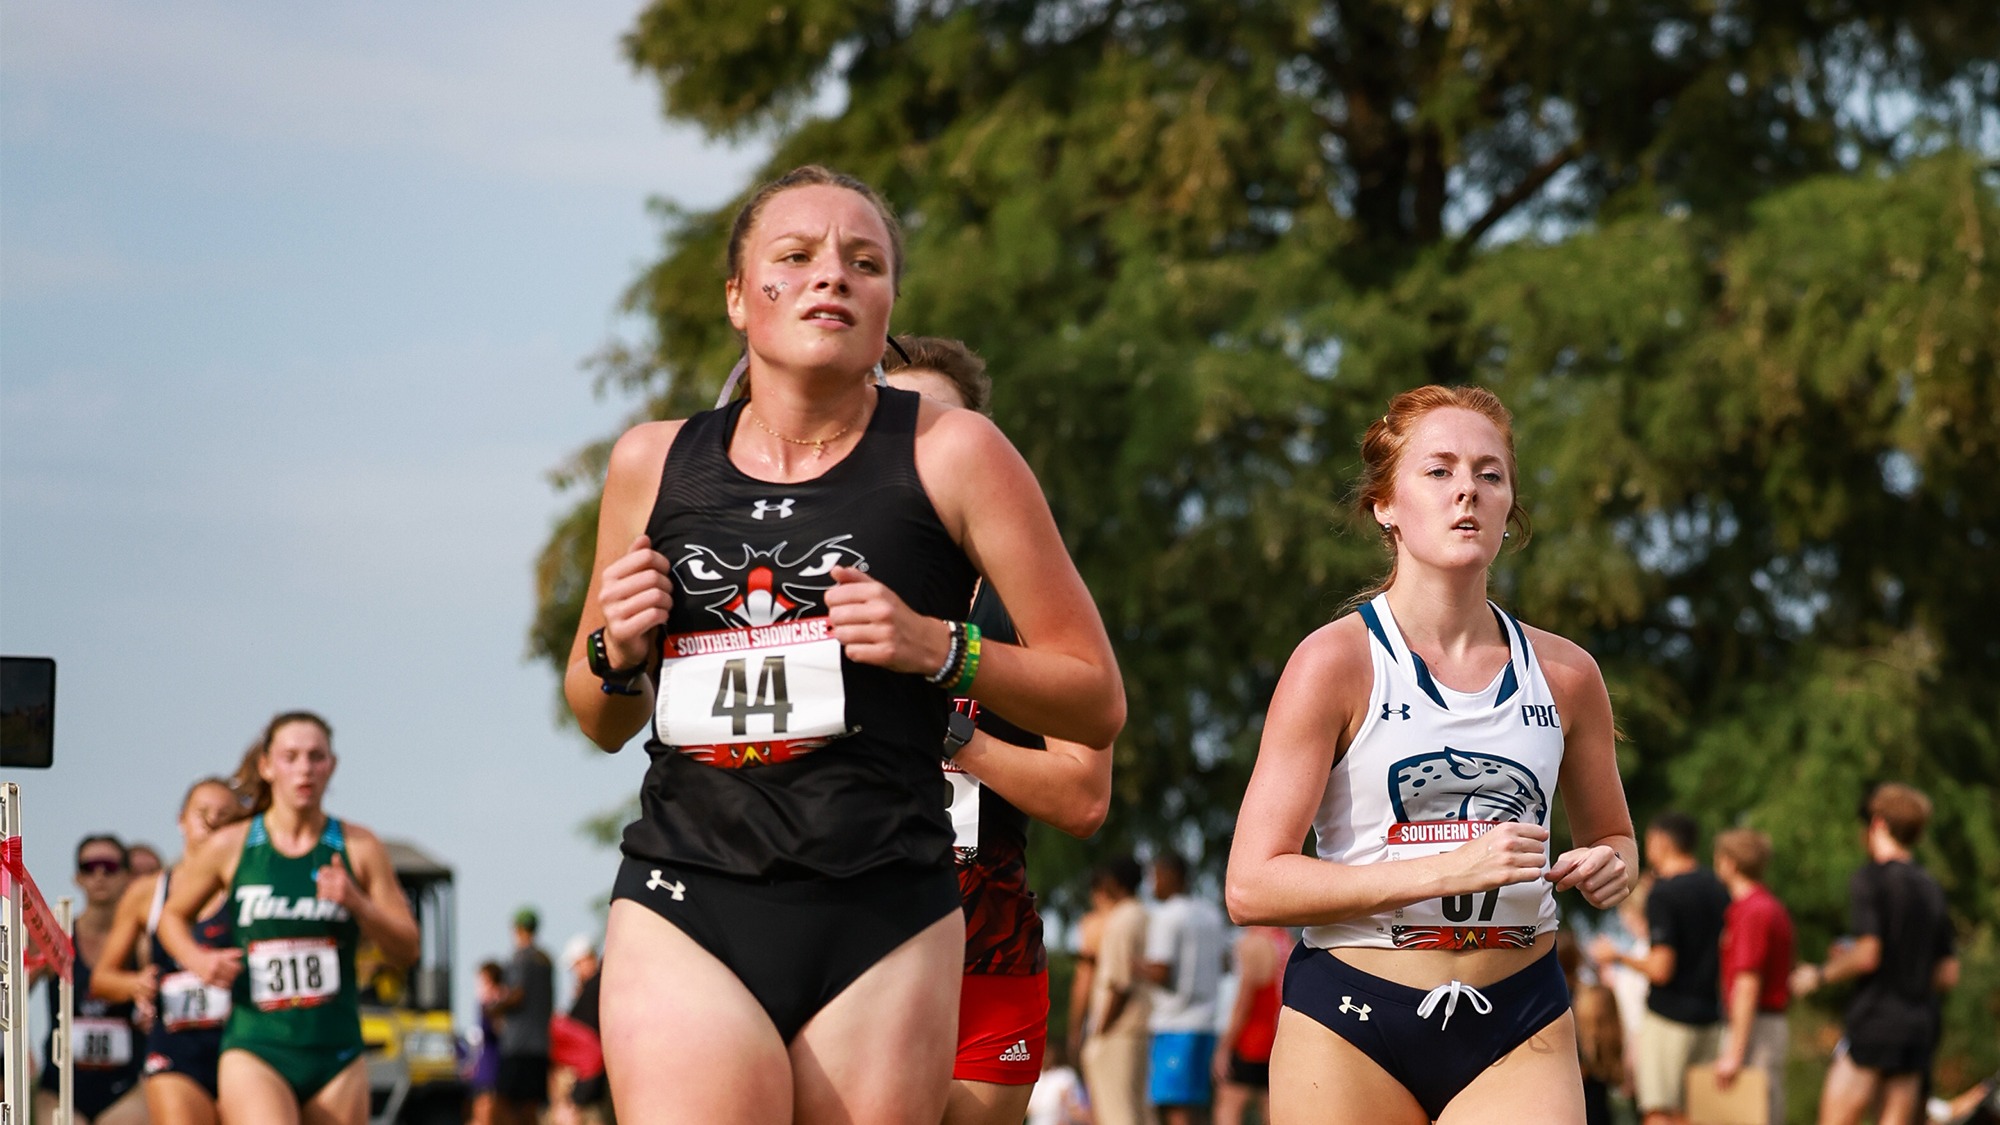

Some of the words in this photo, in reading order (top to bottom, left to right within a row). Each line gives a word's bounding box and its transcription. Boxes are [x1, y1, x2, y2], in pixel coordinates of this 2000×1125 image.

[678, 631, 749, 656] SOUTHERN
[751, 620, 827, 648] SHOWCASE
[711, 655, 793, 736] 44
[1401, 823, 1469, 842] SOUTHERN
[268, 955, 322, 992] 318
[999, 1053, 1030, 1061] adidas
